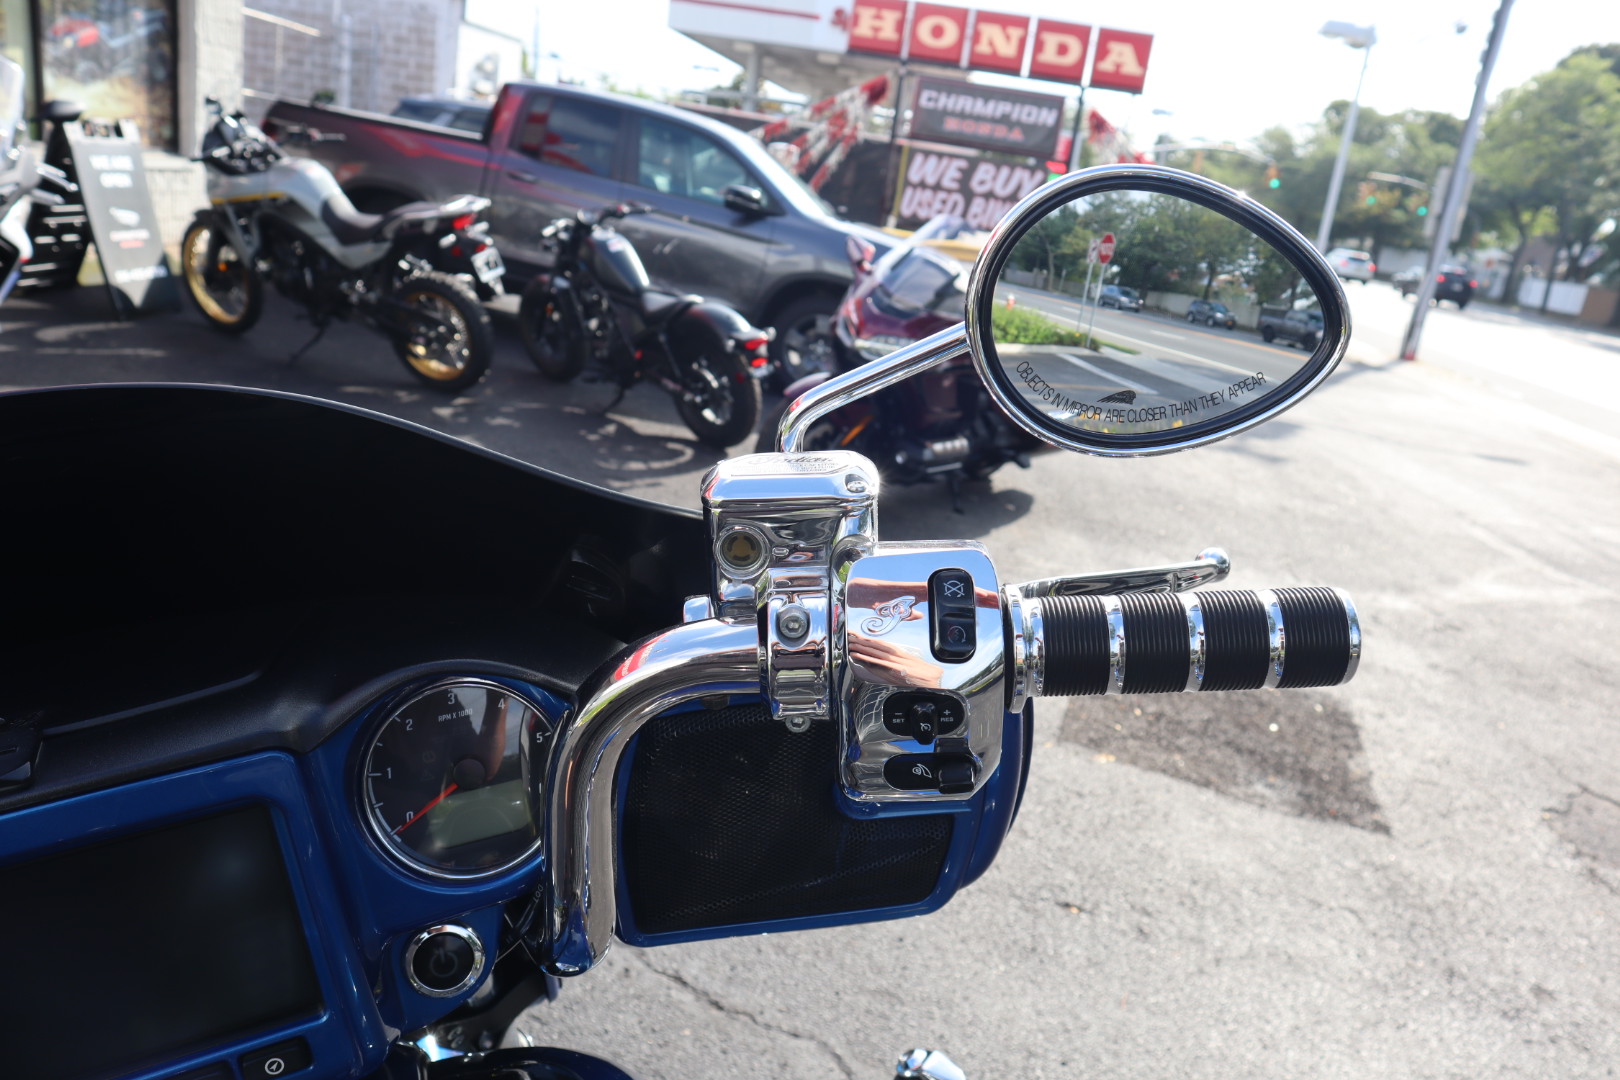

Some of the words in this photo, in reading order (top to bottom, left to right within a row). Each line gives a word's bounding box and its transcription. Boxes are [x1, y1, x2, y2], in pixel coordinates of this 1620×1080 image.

[853, 5, 1146, 77] HONDA
[918, 88, 1059, 127] CHAMPION
[907, 152, 969, 190] WE
[969, 161, 1045, 200] BUY
[900, 186, 966, 221] USED
[1016, 361, 1055, 401] OBJECTS
[1104, 408, 1126, 423] ARE
[1127, 406, 1167, 423] CLOSER
[1169, 398, 1198, 418] THAN
[1199, 389, 1225, 410] THEY
[1228, 371, 1267, 400] APPEAR
[447, 693, 456, 705] 3
[497, 698, 506, 710] 4
[438, 713, 452, 723] RPM
[458, 708, 473, 718] 1000
[406, 718, 414, 731] 2
[536, 732, 543, 744] 5
[387, 767, 392, 779] 1
[406, 811, 414, 822] 0
